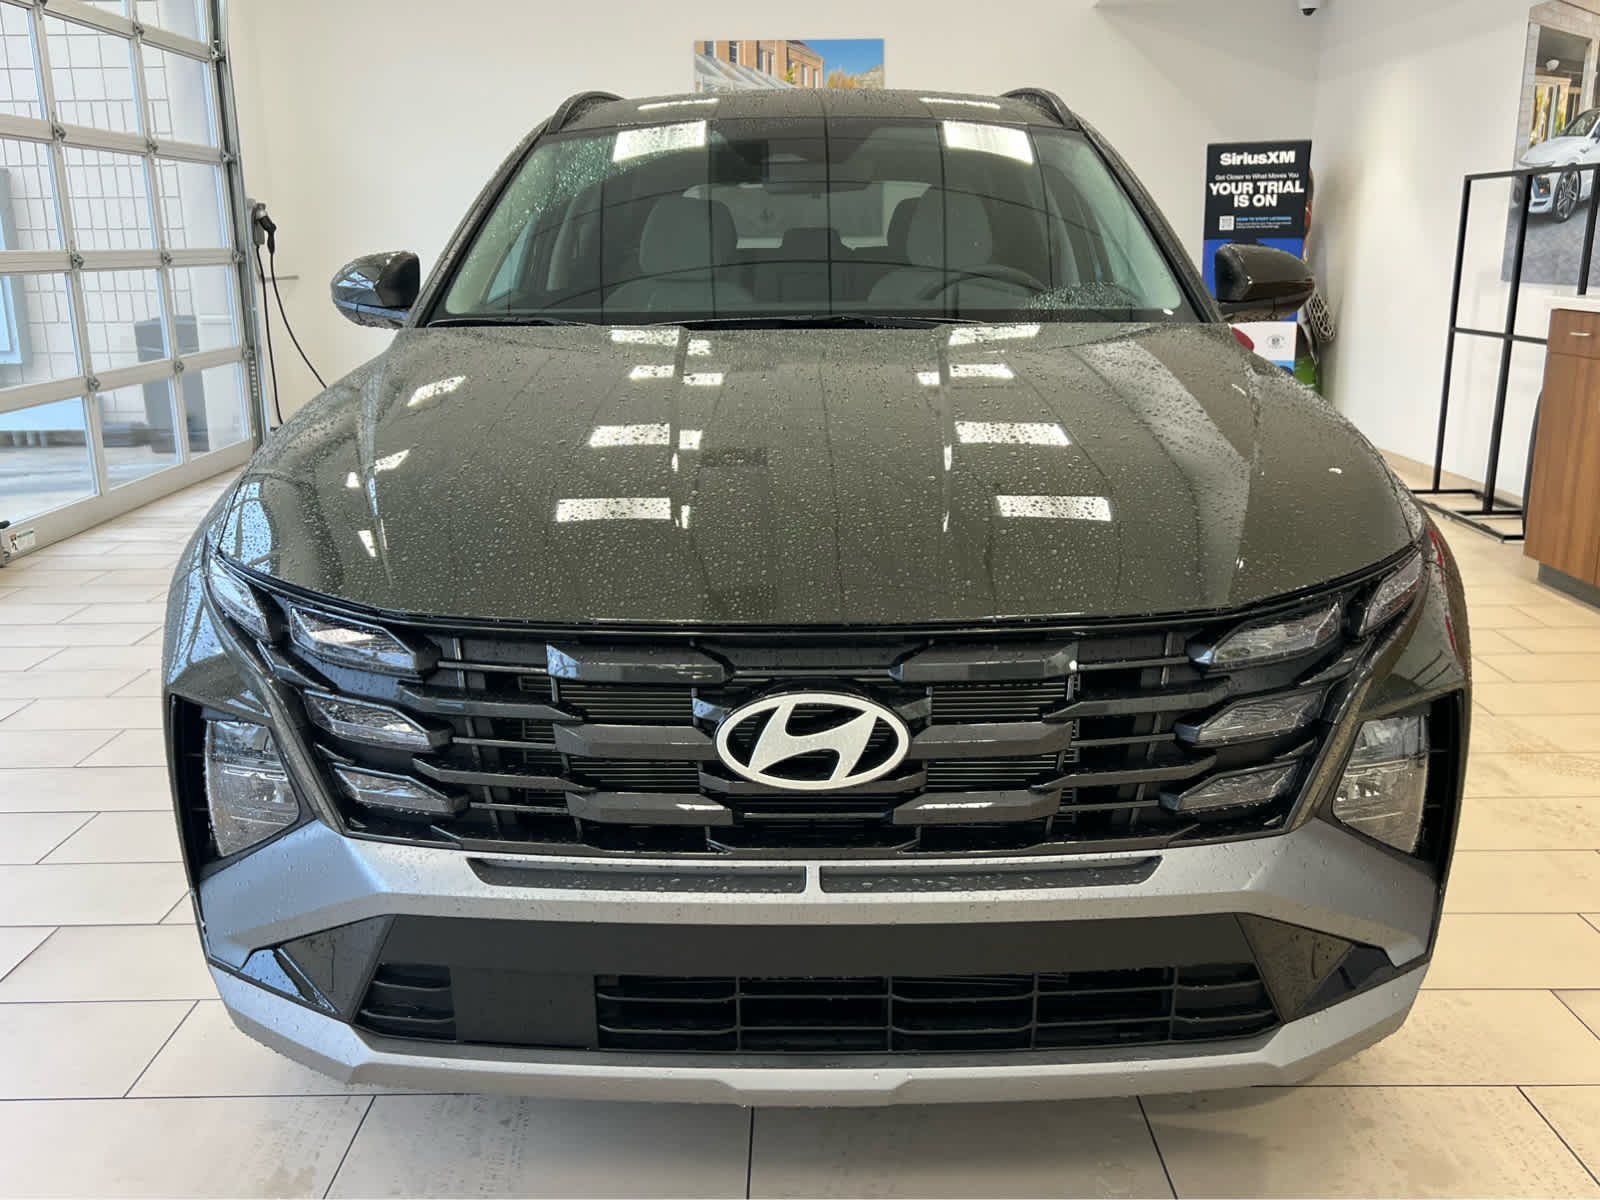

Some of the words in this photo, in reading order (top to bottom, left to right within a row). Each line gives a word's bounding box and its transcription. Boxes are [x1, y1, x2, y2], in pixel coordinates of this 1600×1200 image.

[1220, 151, 1296, 165] SiriusXM
[1209, 182, 1253, 195] YOUR
[1257, 180, 1304, 194] TRIAL
[1234, 194, 1250, 207] IS
[1252, 194, 1278, 207] ON
